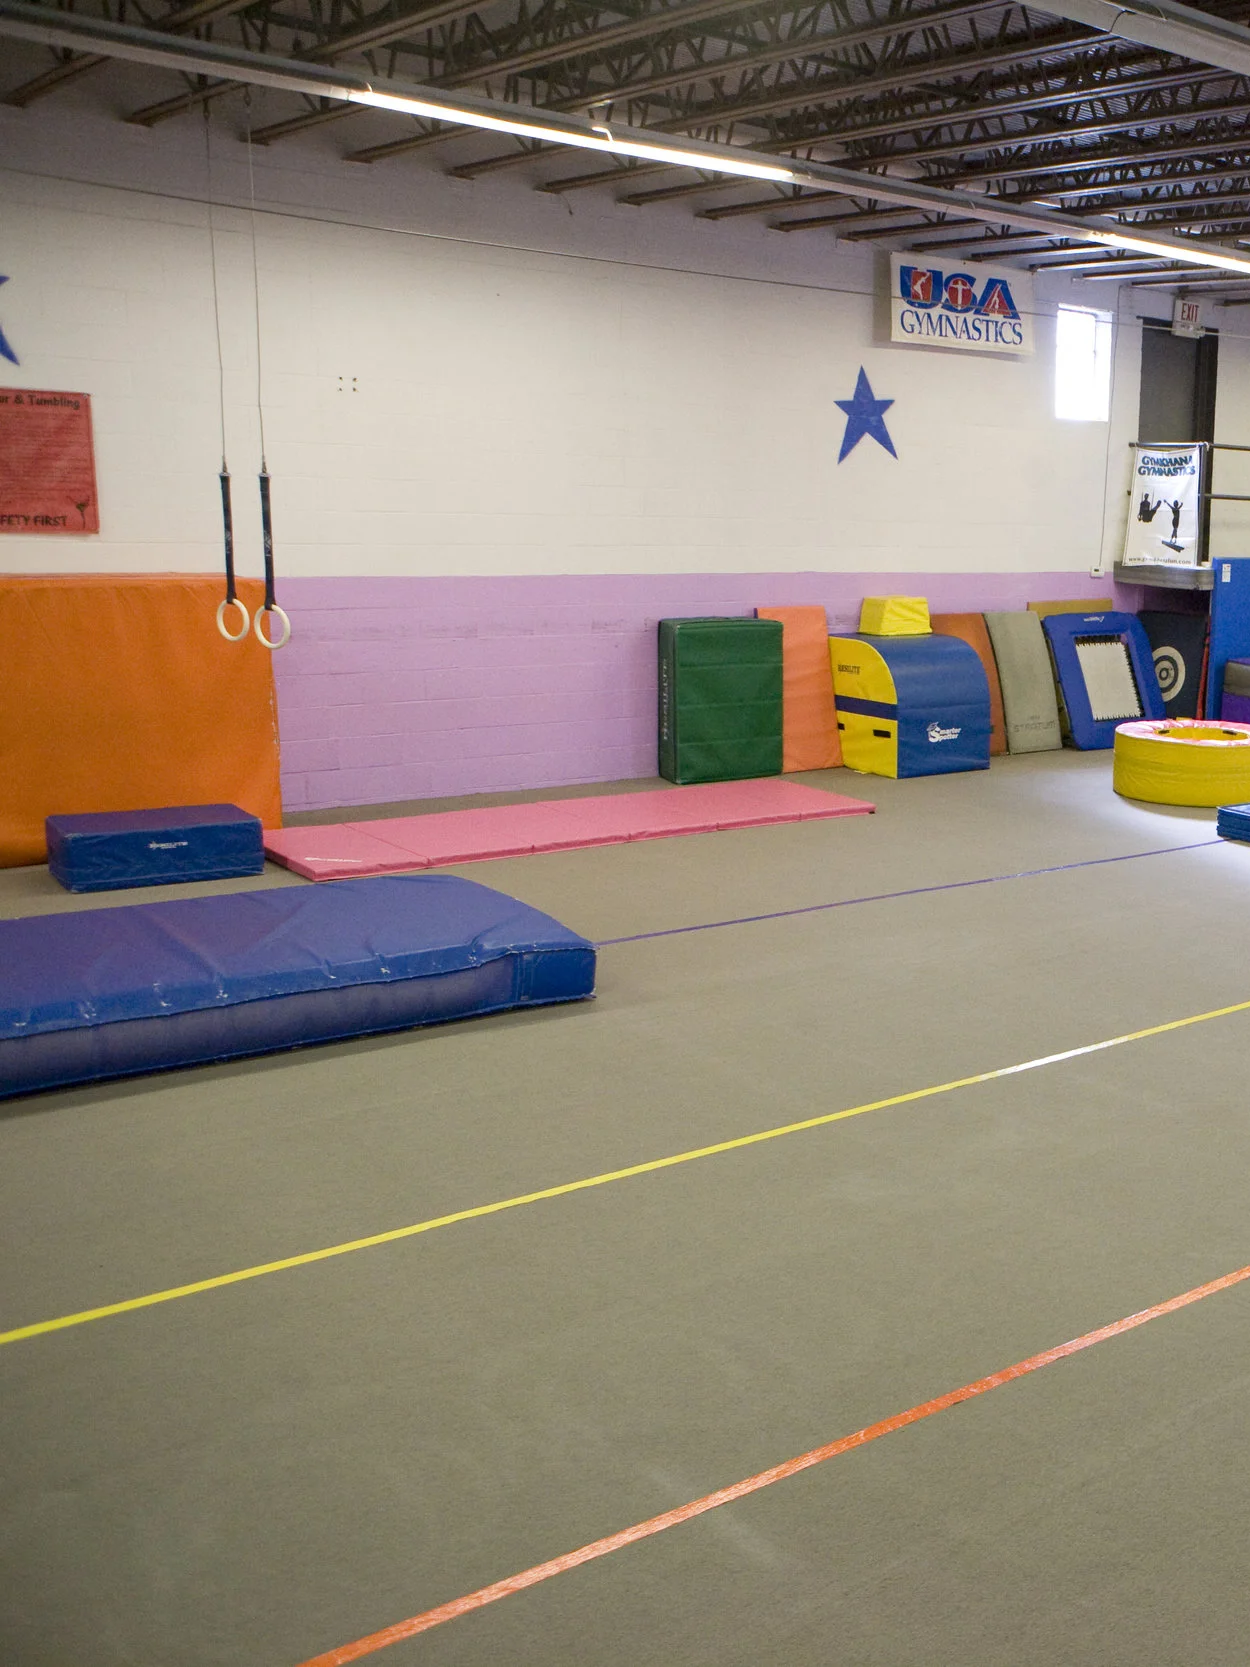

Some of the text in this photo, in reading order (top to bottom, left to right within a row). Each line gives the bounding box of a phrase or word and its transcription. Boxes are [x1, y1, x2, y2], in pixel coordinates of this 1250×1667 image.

[900, 265, 1021, 320] USA
[1181, 303, 1200, 322] EXIT
[900, 309, 1023, 345] GYMNASTICS
[28, 395, 80, 410] Tumbling
[1138, 465, 1196, 476] GYMNASTICS
[33, 515, 68, 527] FIRST
